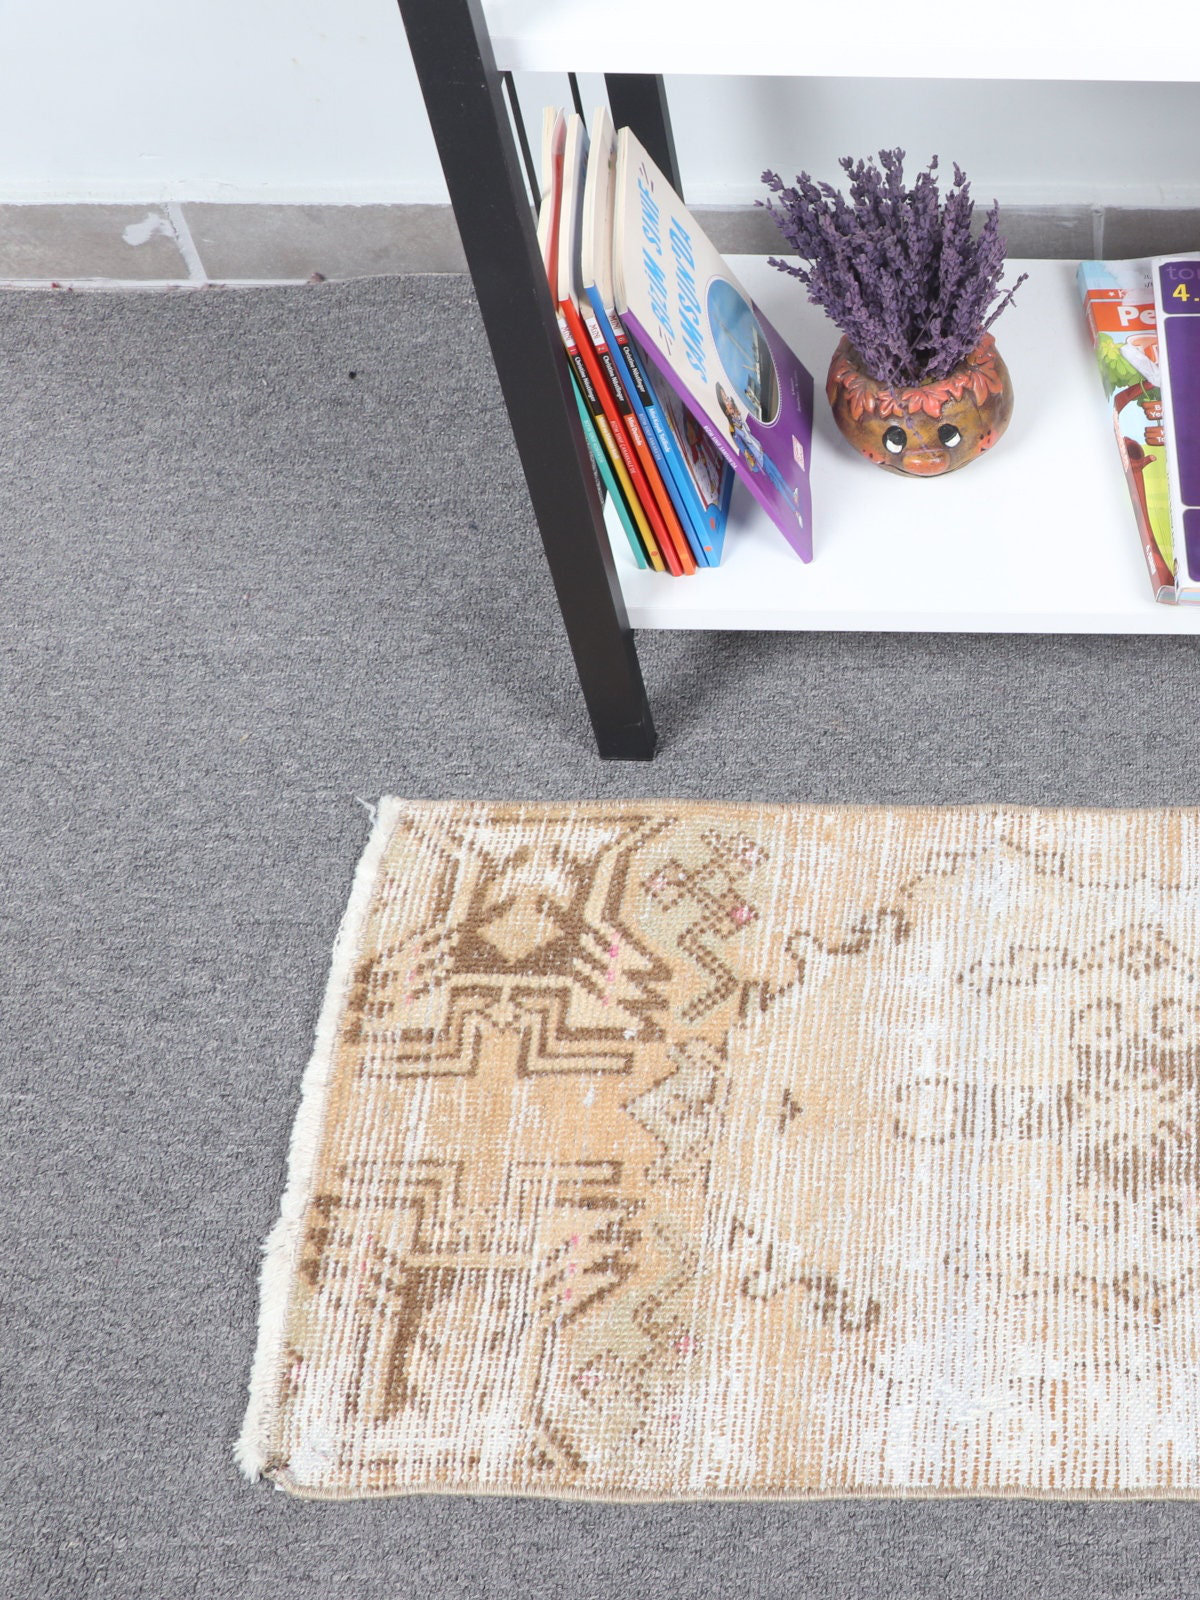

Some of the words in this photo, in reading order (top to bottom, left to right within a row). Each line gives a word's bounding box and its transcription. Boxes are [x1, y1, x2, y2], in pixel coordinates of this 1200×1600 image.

[638, 178, 662, 257] SINIF
[642, 247, 675, 341] BİZİM
[669, 215, 707, 384] SAMSUN'DA
[575, 356, 587, 378] Christine
[603, 355, 615, 377] Christine
[623, 346, 635, 368] Christine
